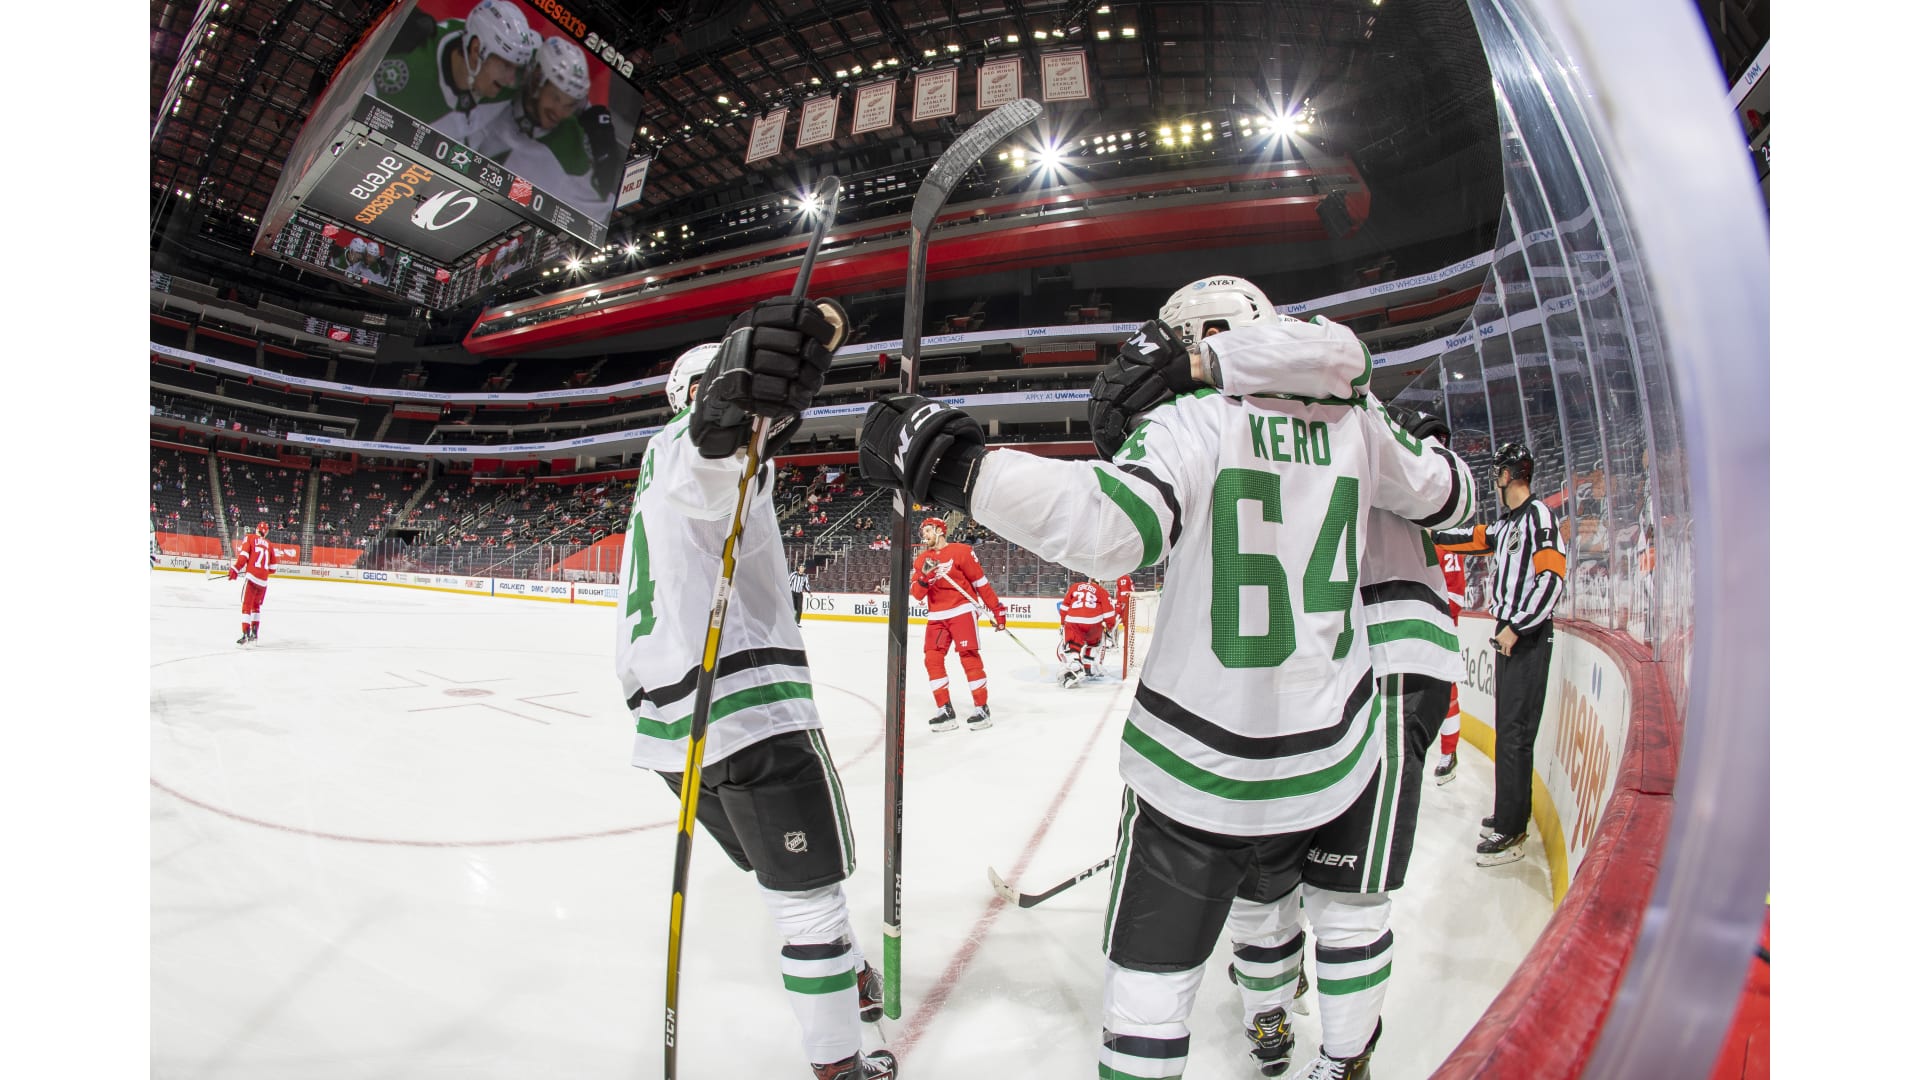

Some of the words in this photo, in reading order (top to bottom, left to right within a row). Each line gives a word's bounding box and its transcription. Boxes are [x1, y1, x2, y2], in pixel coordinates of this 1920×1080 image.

[584, 31, 634, 79] arena
[1744, 62, 1762, 85] UWM
[435, 141, 449, 160] 0
[349, 156, 403, 200] arena
[480, 167, 503, 187] 2:38
[354, 181, 415, 225] Caesars
[532, 194, 544, 212] 0
[1208, 279, 1237, 287] AT&T
[1369, 283, 1395, 295] UNITED
[1396, 273, 1439, 289] WHOLESALE
[1439, 260, 1477, 278] MORTGAGE
[1287, 304, 1307, 313] UWM
[1027, 328, 1047, 336] UWM
[1112, 324, 1138, 332] UNITED
[866, 343, 888, 351] UNITED
[927, 335, 965, 345] MORTGAGE
[1025, 393, 1044, 401] APPLY
[813, 406, 865, 416] UWMcareers.com
[1248, 413, 1332, 466] KERO
[1543, 528, 1549, 540] 7
[170, 558, 192, 568] xfinity
[254, 547, 269, 570] 71
[1443, 553, 1461, 573] 21
[311, 567, 330, 578] meijer
[1211, 467, 1360, 669] 64
[363, 572, 388, 581] GEICO
[499, 582, 525, 591] FALKEN
[531, 585, 544, 593] DMC
[551, 586, 567, 594] DOCS
[805, 595, 835, 611] JOE'S
[854, 604, 879, 616] Blue
[1010, 604, 1031, 614] First
[1554, 661, 1611, 854] meijer
[1306, 848, 1358, 871] AUER
[665, 1007, 676, 1048] CCM
